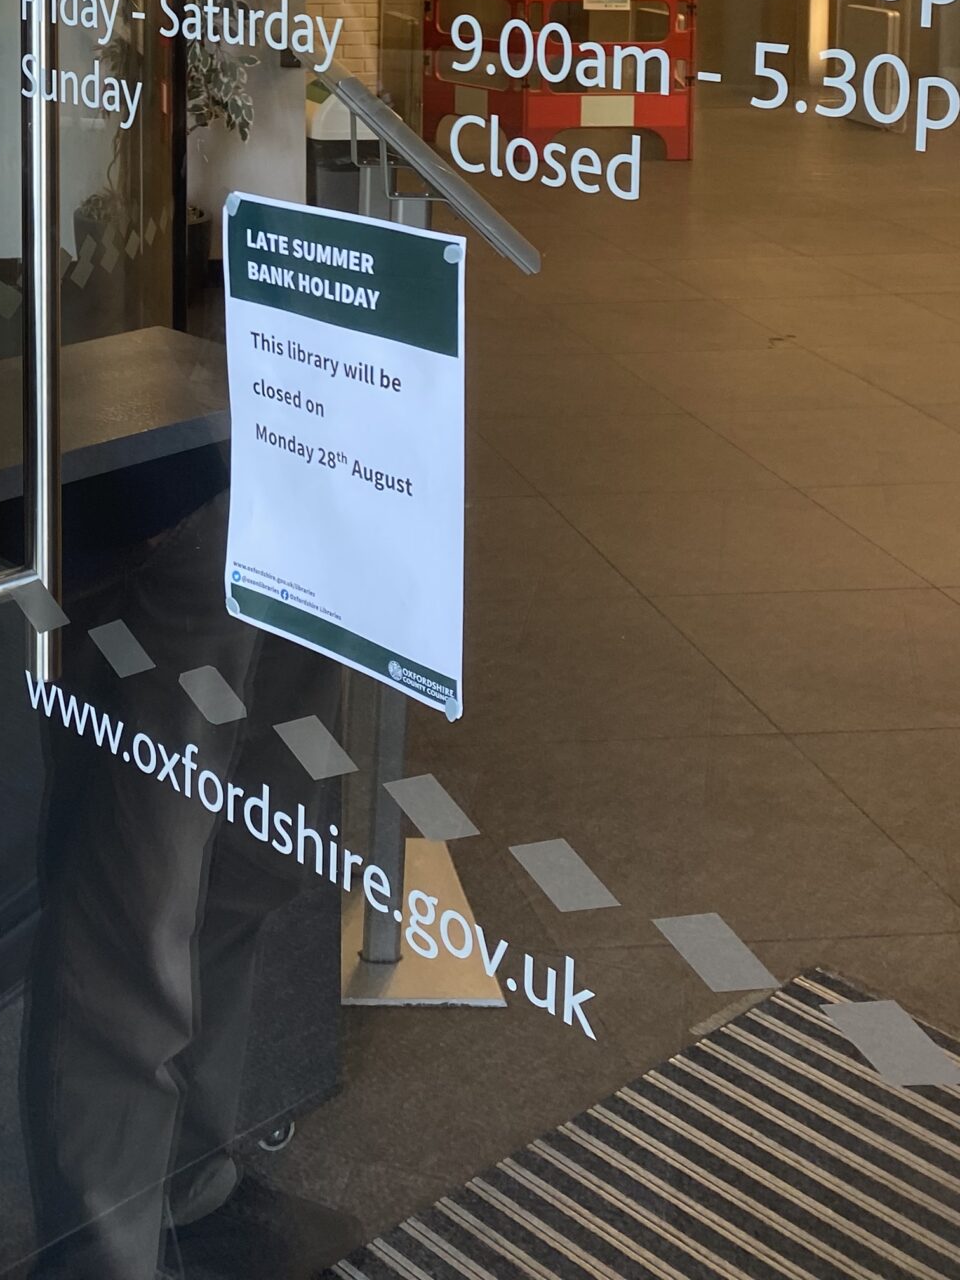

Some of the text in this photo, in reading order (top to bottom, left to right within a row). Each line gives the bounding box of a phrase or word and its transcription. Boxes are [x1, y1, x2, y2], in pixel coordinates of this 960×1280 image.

[132, 11, 146, 20] -
[451, 14, 671, 95] 9.00am
[697, 71, 722, 82] -
[750, 41, 960, 152] 5.30p
[21, 53, 641, 200] Sunday Closed
[246, 228, 375, 275] LATE SUMMER
[247, 260, 381, 311] BANK HOLIDAY
[250, 331, 402, 393] This library will be
[253, 378, 325, 417] closed on
[255, 422, 414, 497] Monday 28th August
[233, 561, 316, 598] www.oxfordshire.gov.uk/libraries
[241, 575, 280, 595] @oxonlibraries
[289, 593, 342, 621] Oxfordshire Libraries
[402, 667, 455, 698] OXFORDSHIRE
[402, 676, 449, 702] COUNTY COUNC
[25, 670, 597, 1041] www.oxfordshire.gov.uk
